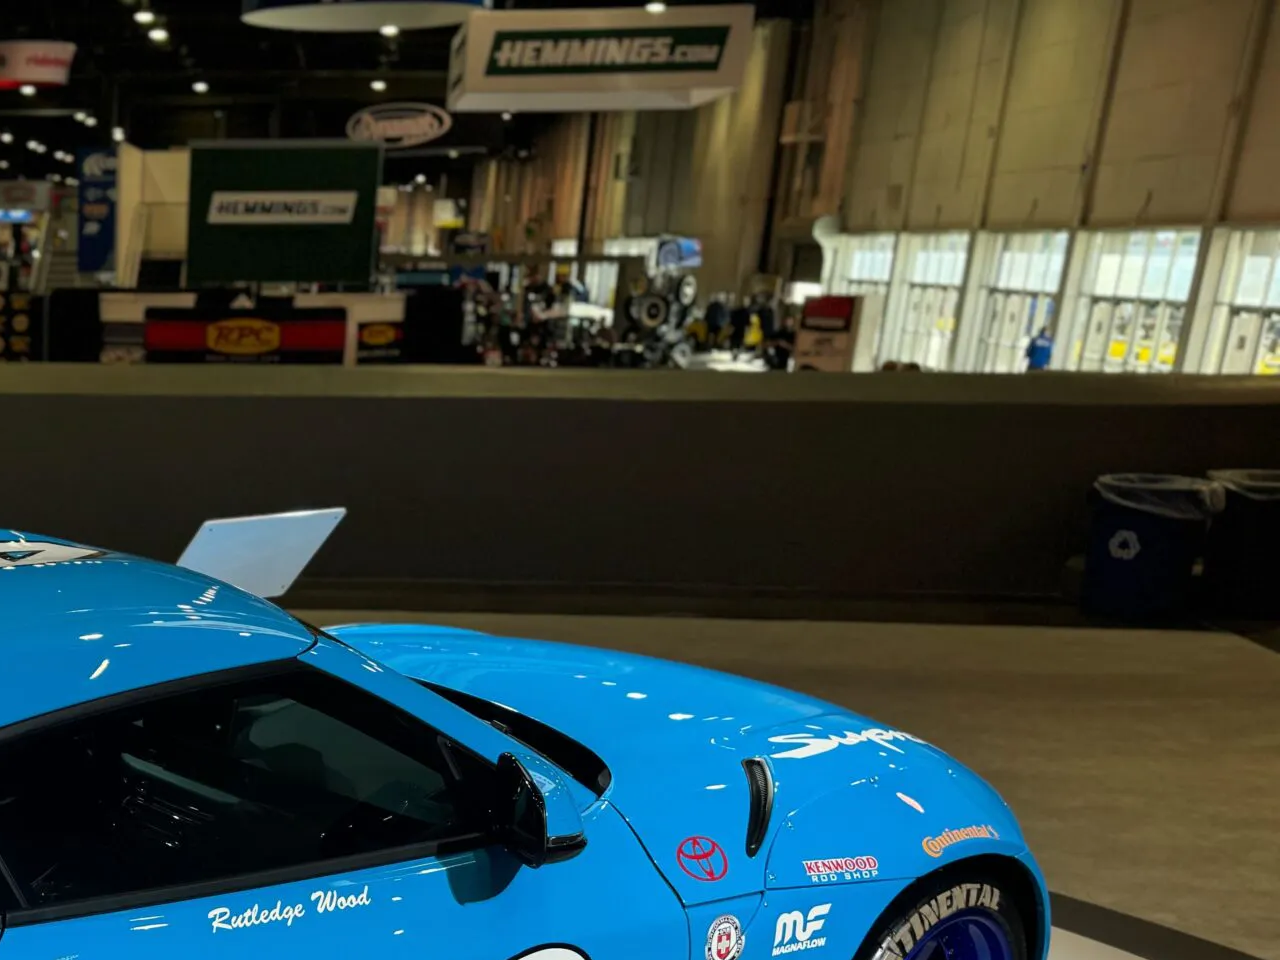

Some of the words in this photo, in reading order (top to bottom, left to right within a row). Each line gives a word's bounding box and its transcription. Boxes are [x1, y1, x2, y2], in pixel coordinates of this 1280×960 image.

[802, 856, 879, 875] KENWOOD
[812, 873, 837, 884] ROD
[845, 871, 879, 882] SHOP
[207, 900, 306, 933] Rutledge
[310, 885, 372, 914] Wood
[772, 937, 827, 957] MAGNAFLOW
